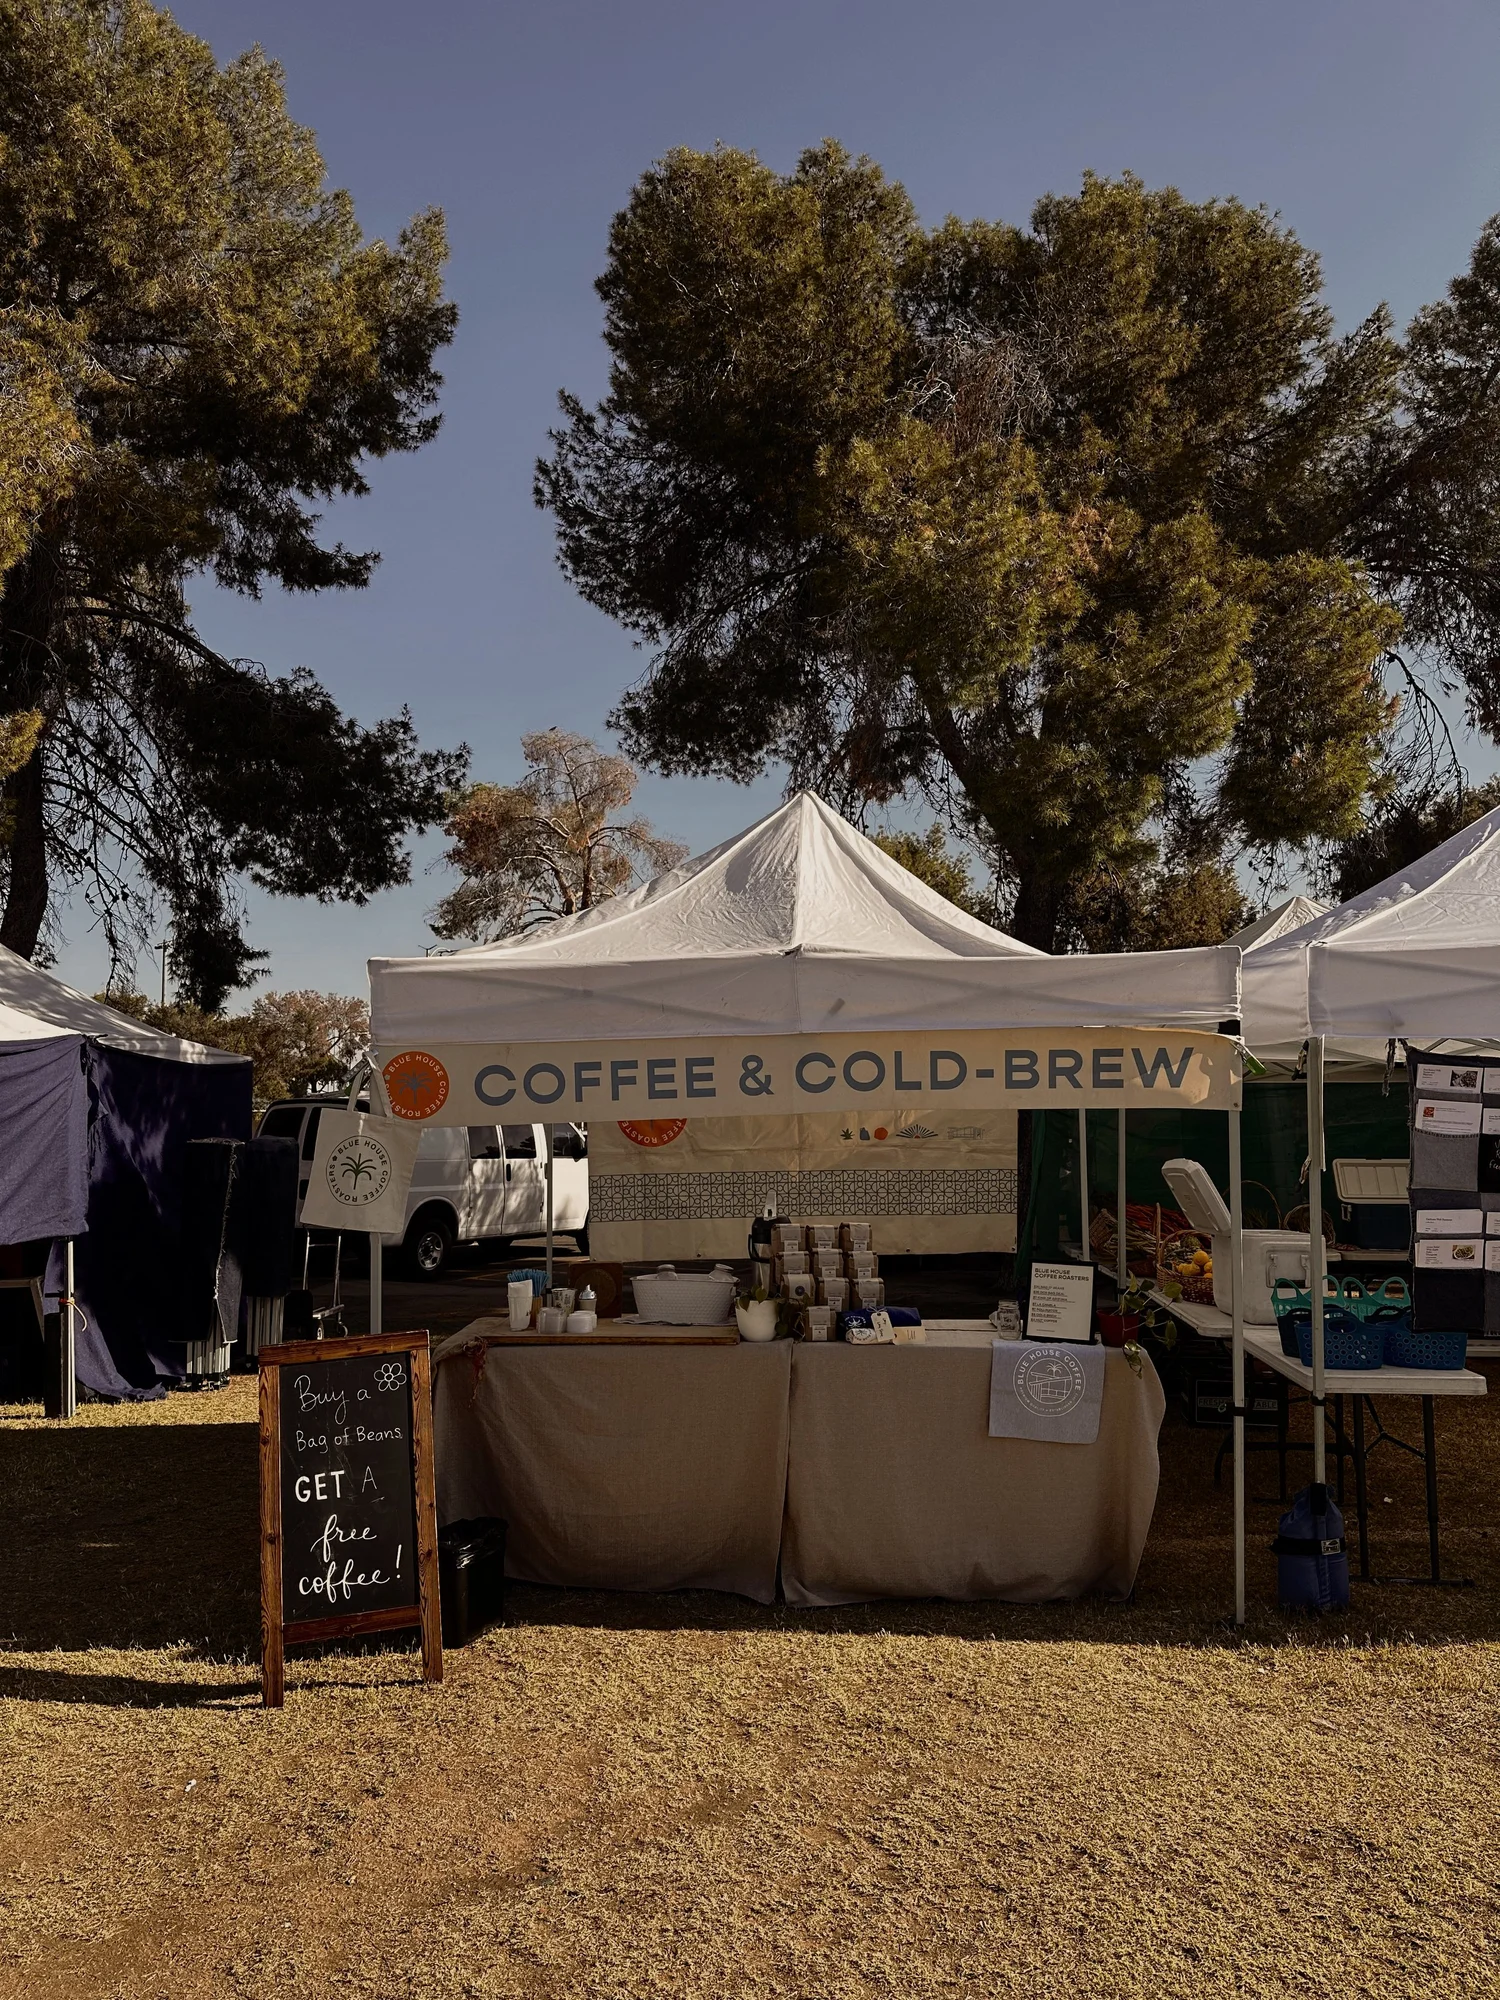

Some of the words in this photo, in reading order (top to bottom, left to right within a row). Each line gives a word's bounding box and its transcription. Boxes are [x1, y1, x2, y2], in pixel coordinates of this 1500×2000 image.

[388, 1055, 411, 1073] BLUE
[415, 1055, 444, 1077] HOUSE
[474, 1056, 717, 1107] COFFEE
[738, 1055, 774, 1097] &
[795, 1046, 1195, 1094] COLD-BREW
[424, 1080, 446, 1114] COFFEE
[337, 1139, 360, 1155] BLUE
[364, 1140, 388, 1166] HOUSE
[329, 1163, 358, 1203] ROASTERS
[362, 1170, 389, 1201] COFFEE
[1058, 1274, 1089, 1282] ROASTERS
[1017, 1360, 1030, 1385] BLUE
[1029, 1349, 1061, 1360] HOUSE
[1064, 1355, 1082, 1391] COFFEE
[294, 1375, 350, 1425] Buy
[357, 1389, 372, 1401] a
[296, 1430, 329, 1454] Bag
[334, 1427, 350, 1446] of
[356, 1426, 403, 1442] Beans
[295, 1470, 345, 1503] GET
[362, 1466, 378, 1493] A
[310, 1514, 378, 1563] free
